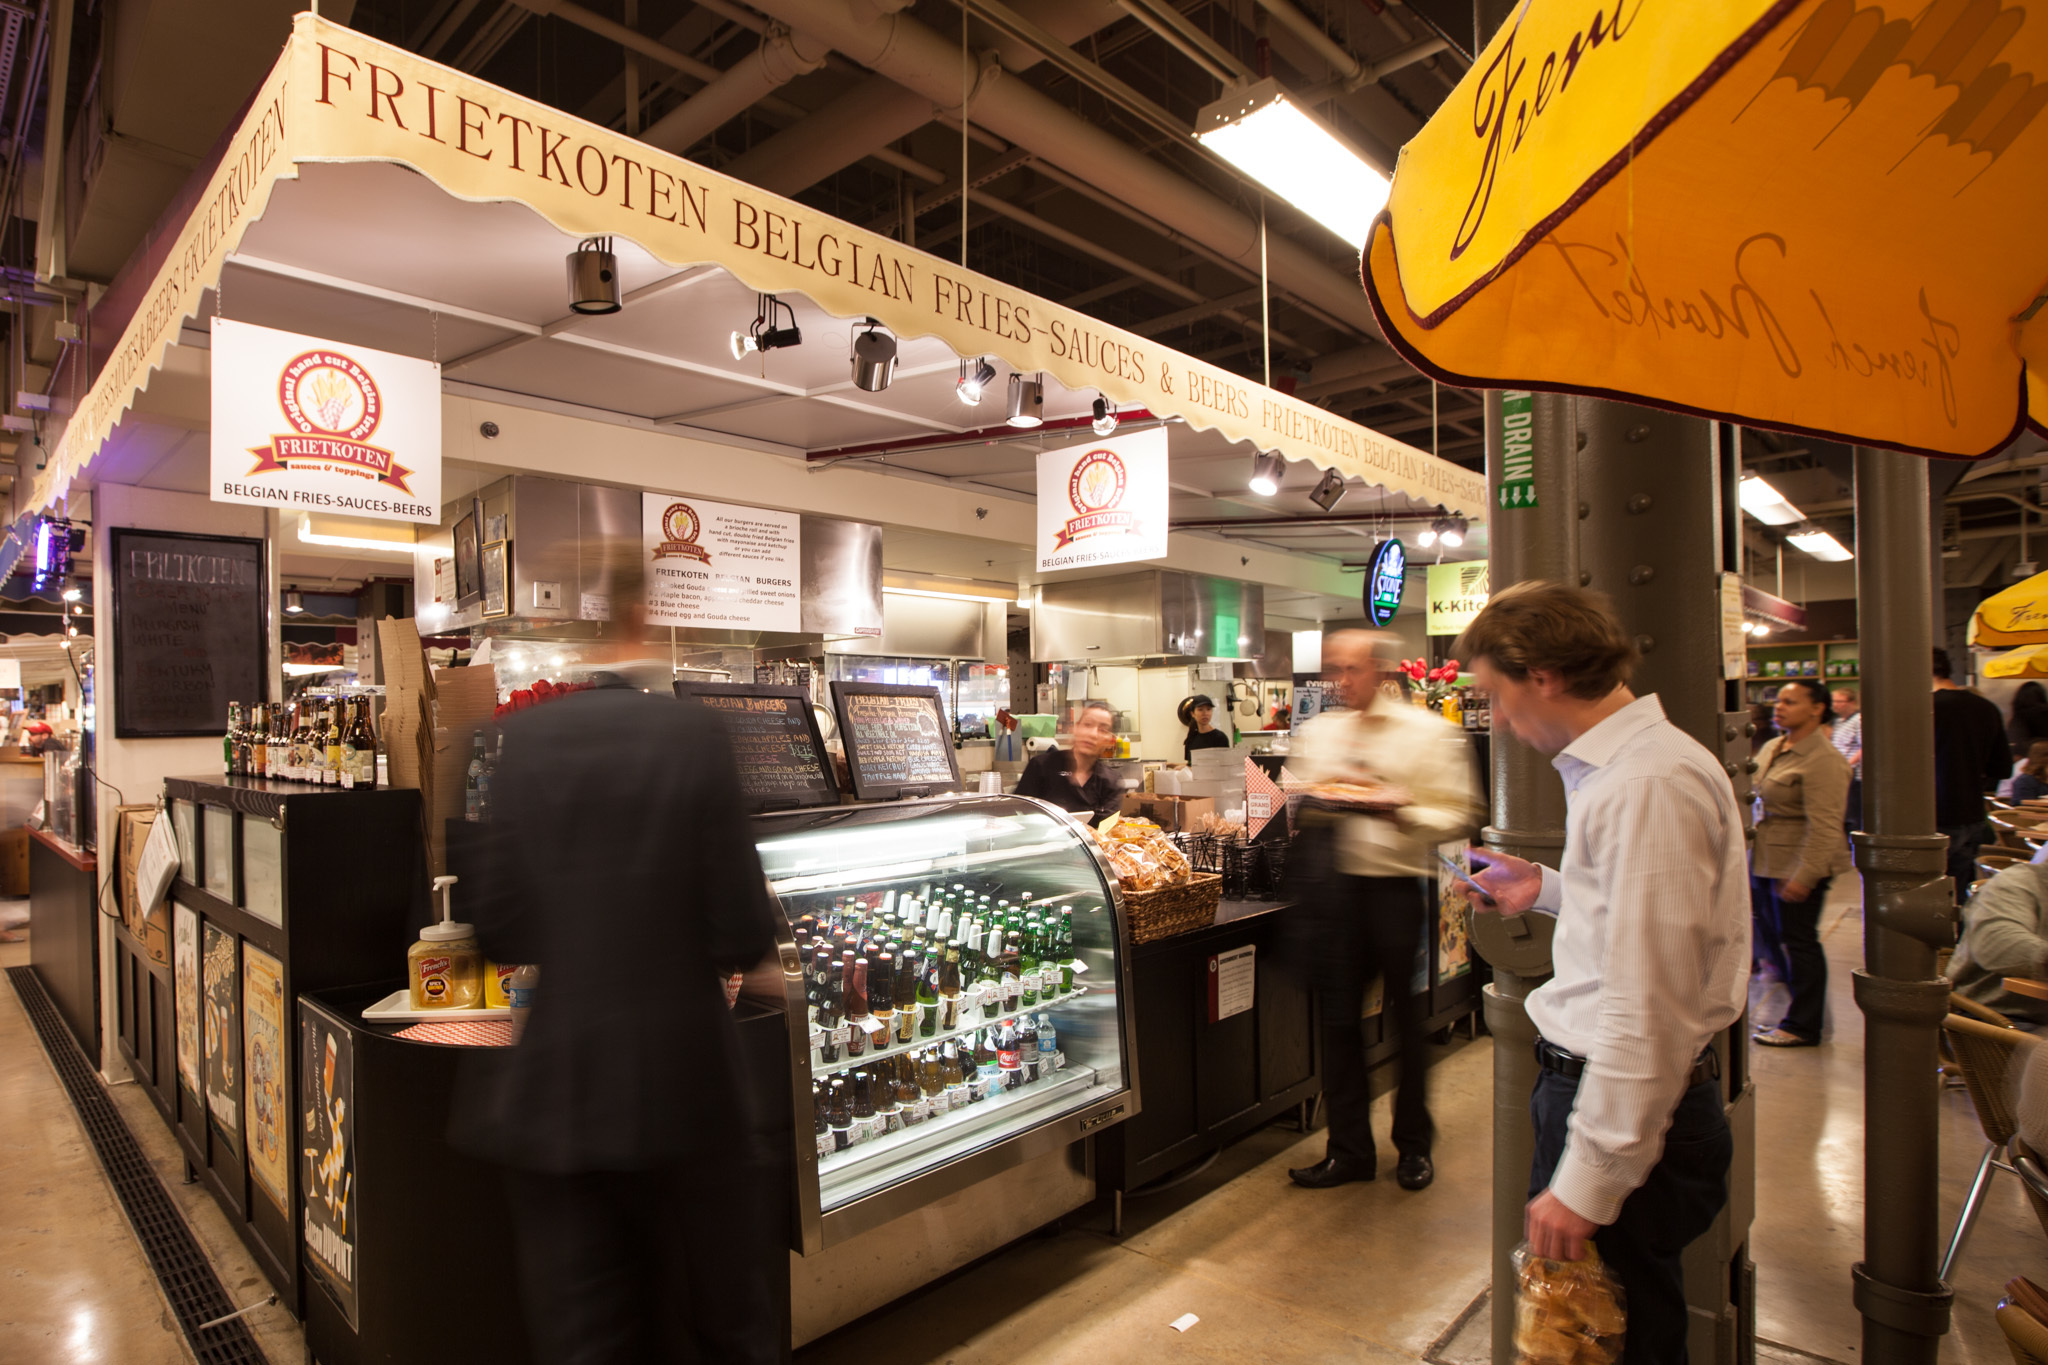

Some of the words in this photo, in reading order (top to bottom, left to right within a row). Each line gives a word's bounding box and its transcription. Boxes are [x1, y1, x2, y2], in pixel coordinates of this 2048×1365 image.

[184, 80, 287, 294] FRIETKOTEN
[315, 42, 709, 233] FRIETKOTEN
[733, 198, 914, 304] BELGIAN
[933, 273, 1145, 385] FRIES-SAUCES
[1160, 361, 1174, 395] &
[1187, 370, 1250, 420] BEERS
[1263, 398, 1359, 460] FRIETKOTEN
[1364, 437, 1418, 480] BELGIAN
[289, 353, 322, 378] hand
[324, 355, 348, 369] cut
[348, 363, 376, 414] Belgian
[284, 377, 312, 433] Original
[349, 413, 376, 439] fries
[279, 438, 387, 468] FRIETKOTEN
[1504, 411, 1532, 481] DRAIN
[290, 463, 321, 471] sauces
[334, 466, 375, 481] toppings
[223, 482, 289, 501] BELGIAN
[293, 490, 432, 518] FRIES-SAUCES-BEERS
[1069, 512, 1131, 533] FRIETKOTEN
[662, 543, 702, 555] FRIETKOTEN
[768, 542, 788, 550] ketchup
[1042, 556, 1074, 567] BELGIAN
[656, 568, 709, 579] FRIETKOTEN
[756, 577, 792, 587] BURGERS
[1374, 575, 1403, 604] STONE
[793, 734, 810, 744] AND
[422, 959, 448, 973] French's
[322, 1222, 353, 1282] DUPONT
